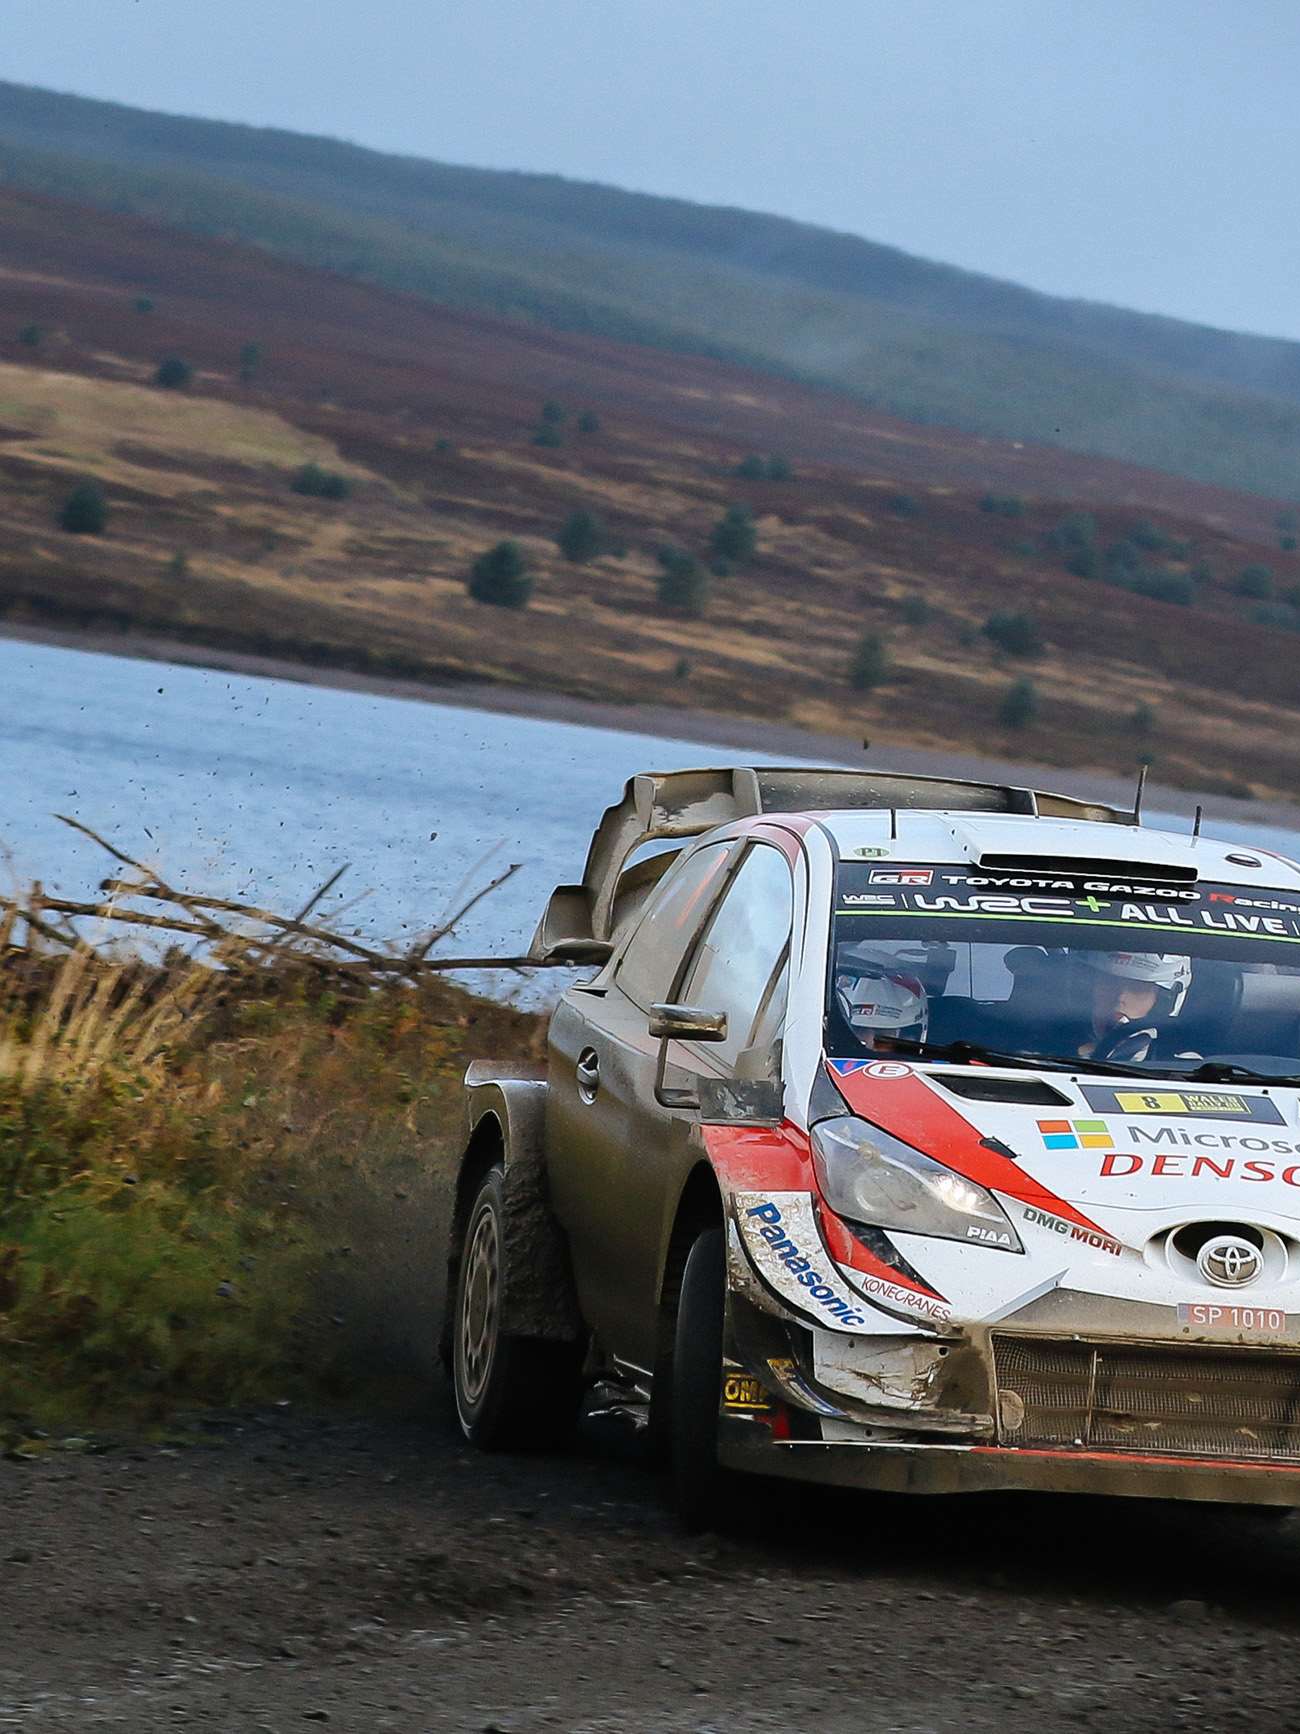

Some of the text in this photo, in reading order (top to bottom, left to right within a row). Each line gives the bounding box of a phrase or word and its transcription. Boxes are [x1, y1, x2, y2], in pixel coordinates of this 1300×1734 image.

[942, 875, 1075, 889] TOYOTA
[1083, 881, 1201, 900] GAZOO
[1121, 903, 1194, 925] ALL
[1200, 910, 1289, 936] LIVE
[1141, 1096, 1161, 1110] 8
[966, 1225, 1011, 1245] PIAA
[1023, 1208, 1122, 1256] DMG MORI
[747, 1202, 865, 1328] Panasonic
[861, 1276, 952, 1323] KONECRANES
[1193, 1306, 1281, 1330] SP 1010
